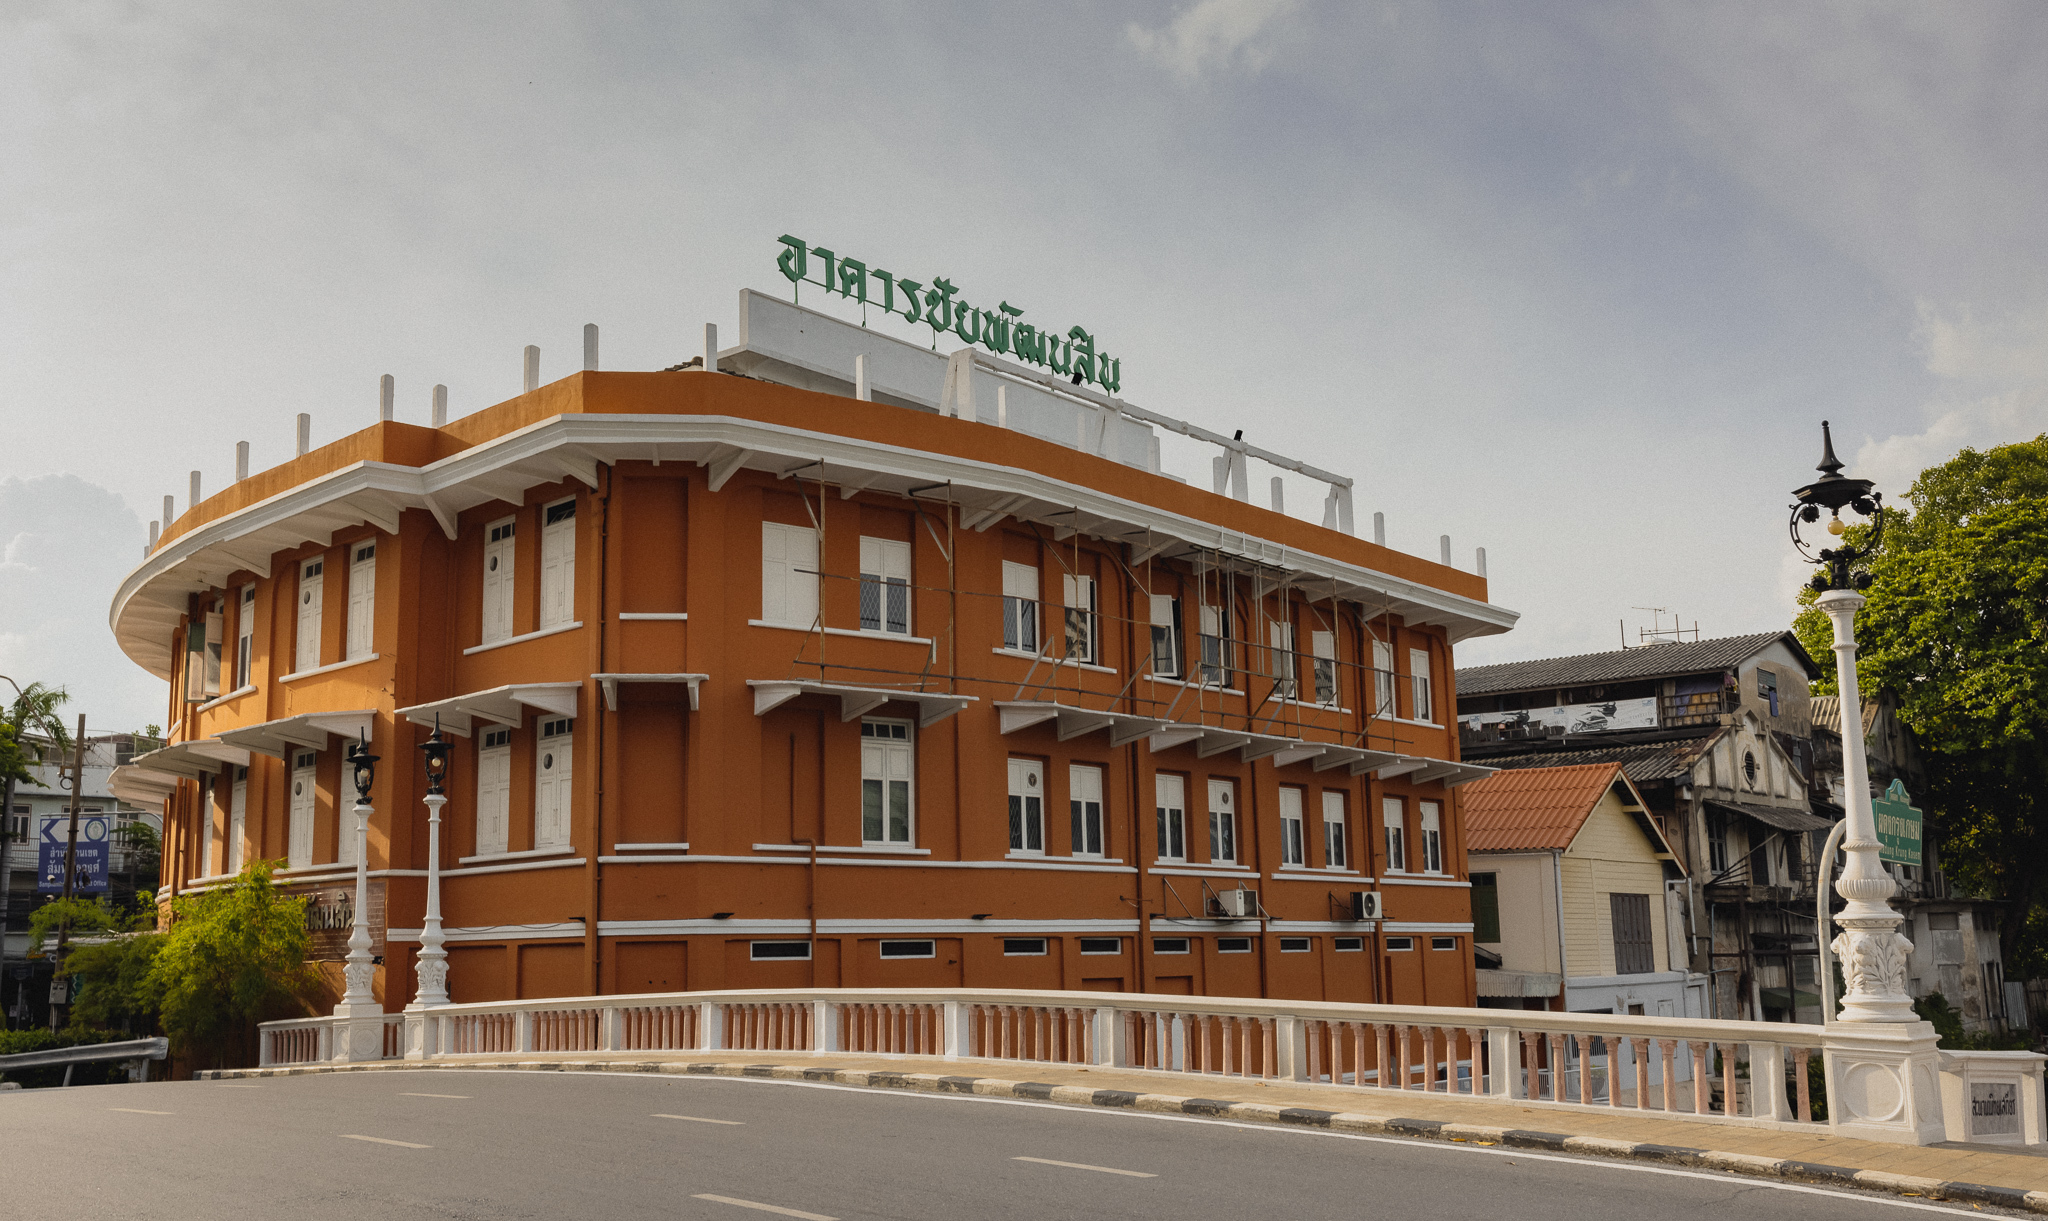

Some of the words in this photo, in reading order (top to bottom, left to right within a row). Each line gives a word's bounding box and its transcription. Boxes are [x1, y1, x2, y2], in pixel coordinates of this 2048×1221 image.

[776, 233, 1122, 393] อาคารชัยพัฒนสิน
[1878, 813, 1920, 845] ผดุงกรุงเกษม
[1895, 845, 1907, 861] Krung
[1908, 847, 1921, 860] Kasem
